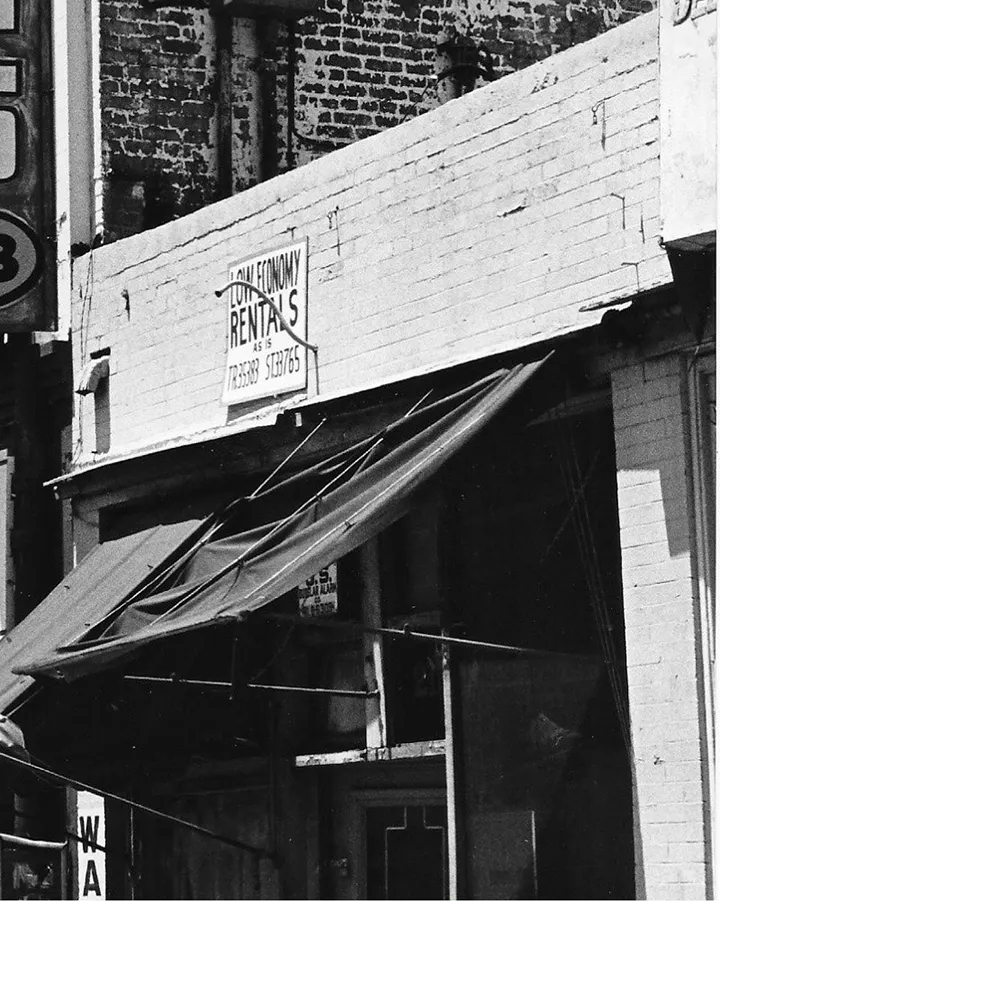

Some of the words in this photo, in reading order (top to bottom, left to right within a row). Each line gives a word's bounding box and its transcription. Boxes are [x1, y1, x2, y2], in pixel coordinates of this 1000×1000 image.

[230, 264, 254, 309] LOW
[257, 249, 301, 299] ECONOMY
[230, 289, 299, 349] RENTALS
